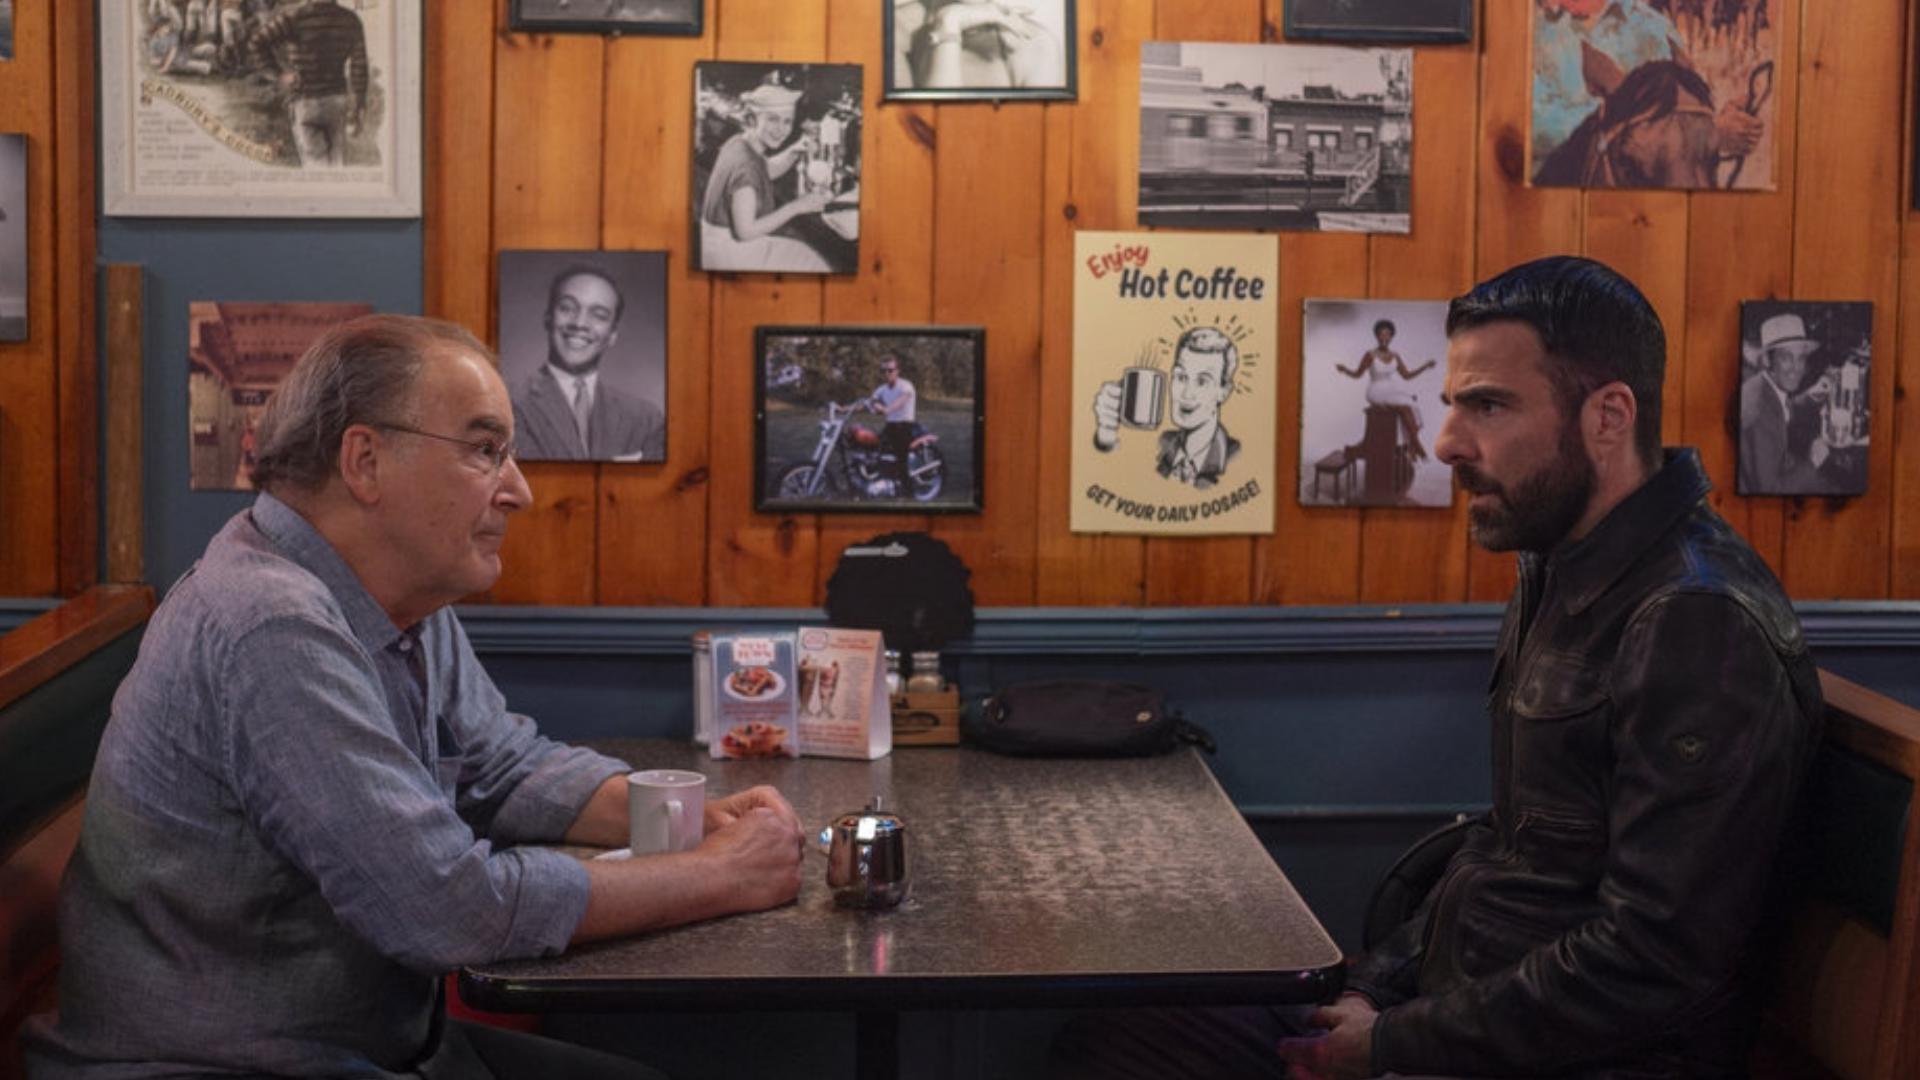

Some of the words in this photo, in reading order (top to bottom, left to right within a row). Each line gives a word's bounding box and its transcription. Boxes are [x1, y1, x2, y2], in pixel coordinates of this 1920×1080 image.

[1087, 243, 1149, 279] Enjoy
[1120, 268, 1169, 299] Hot
[1174, 267, 1264, 299] Coffee
[1086, 484, 1117, 508] GET
[1116, 497, 1156, 521] YOUR
[1157, 504, 1199, 522] DAILY
[1201, 478, 1261, 518] DOSAGE!
